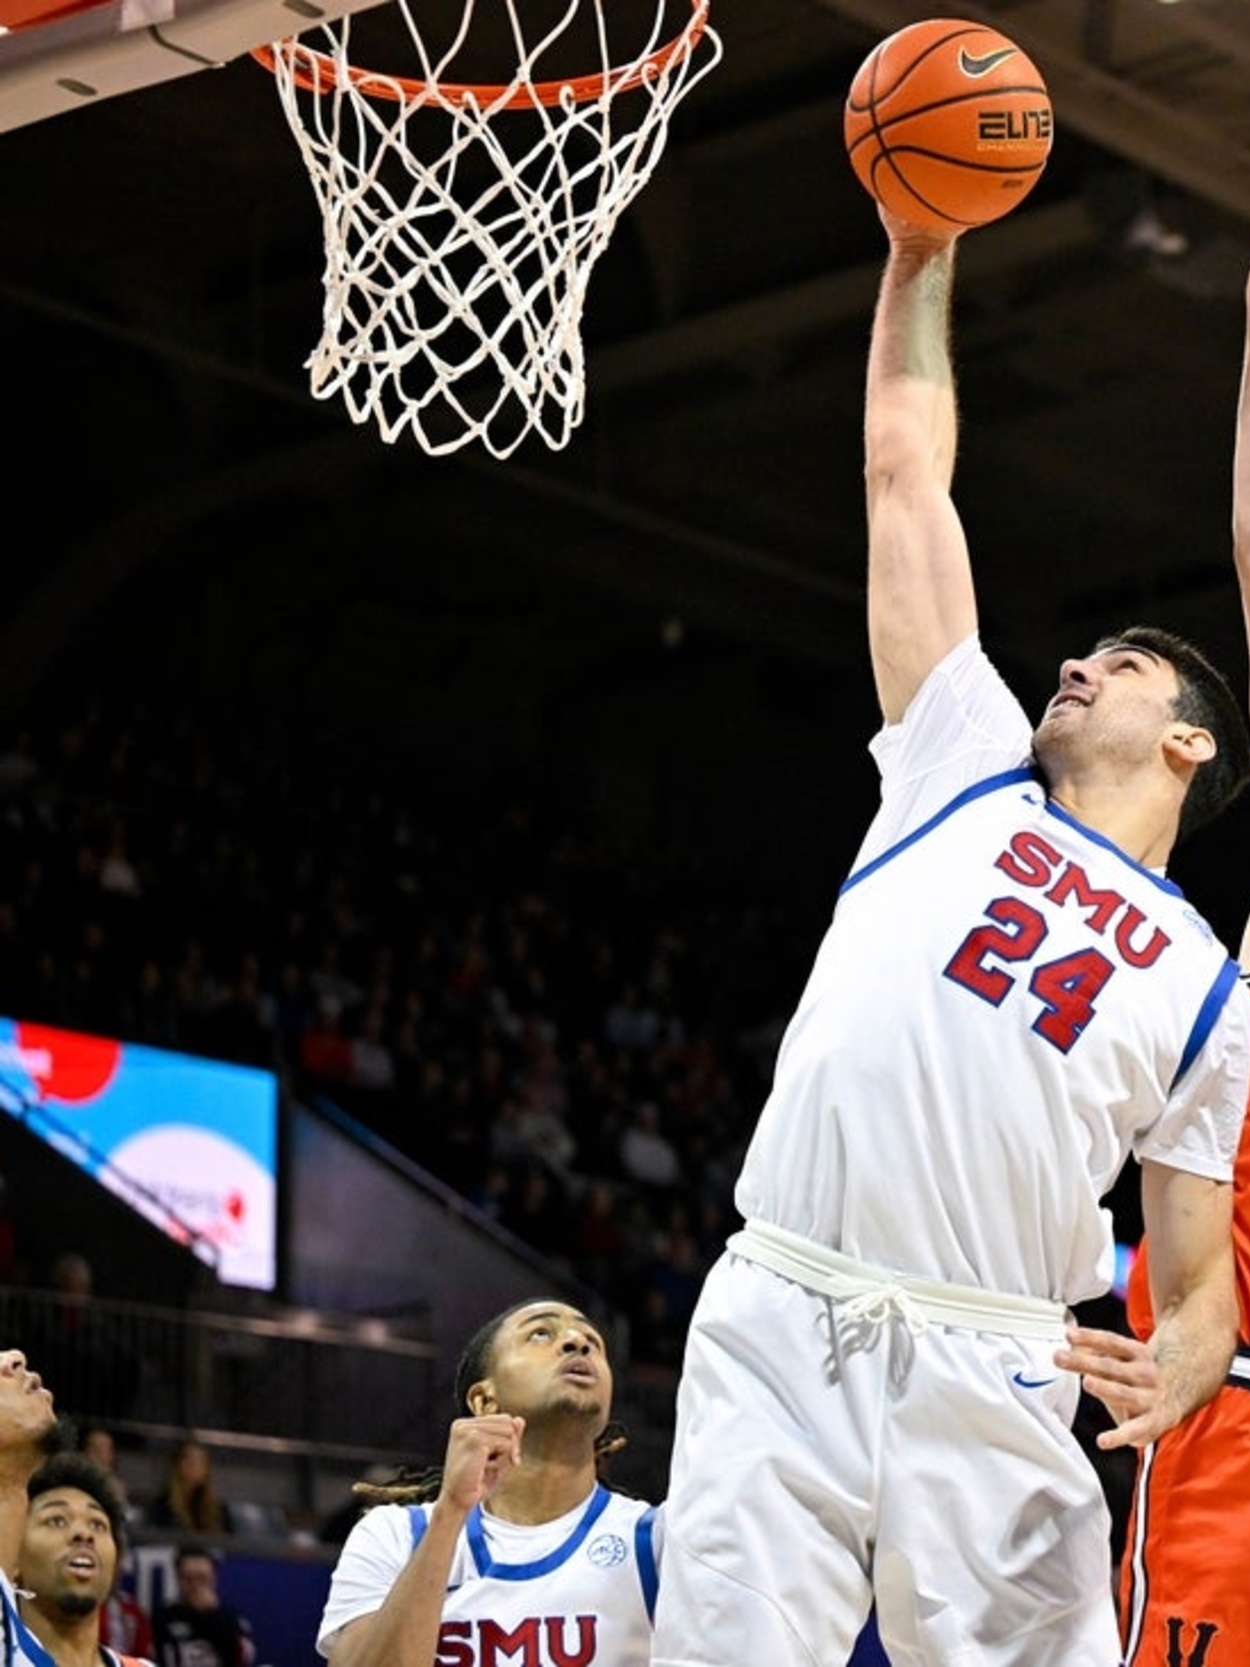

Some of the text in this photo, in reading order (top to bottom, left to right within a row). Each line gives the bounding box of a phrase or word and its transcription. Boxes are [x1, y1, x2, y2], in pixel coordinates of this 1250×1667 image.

[978, 109, 1050, 139] ELITE
[993, 830, 1173, 969] SMU
[942, 895, 1117, 1056] 24
[434, 1614, 598, 1667] SMU
